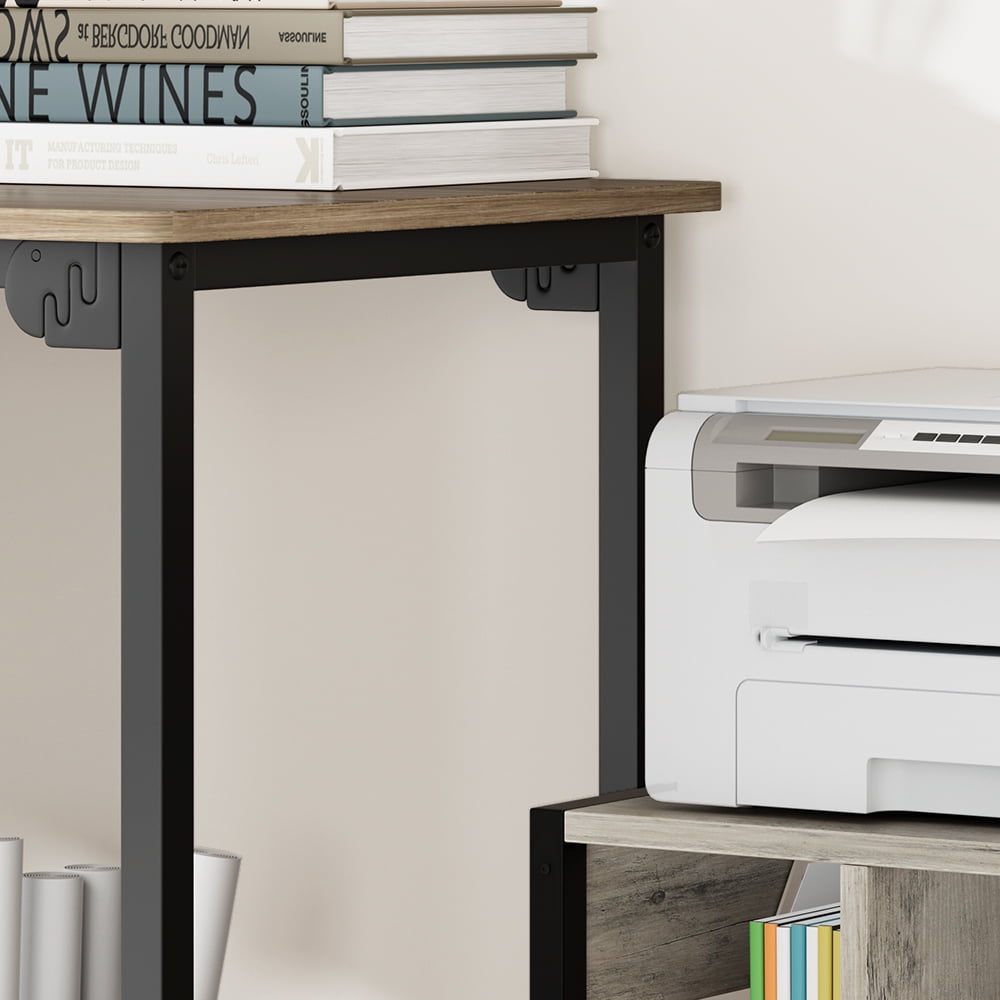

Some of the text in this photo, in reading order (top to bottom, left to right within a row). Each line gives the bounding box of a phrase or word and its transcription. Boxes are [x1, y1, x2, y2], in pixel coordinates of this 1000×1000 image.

[78, 64, 257, 125] WINES
[5, 139, 33, 170] IT
[48, 141, 178, 155] MANUFACTURING TECHNIQUES
[48, 158, 140, 172] FOR PRODUCT DESIGN
